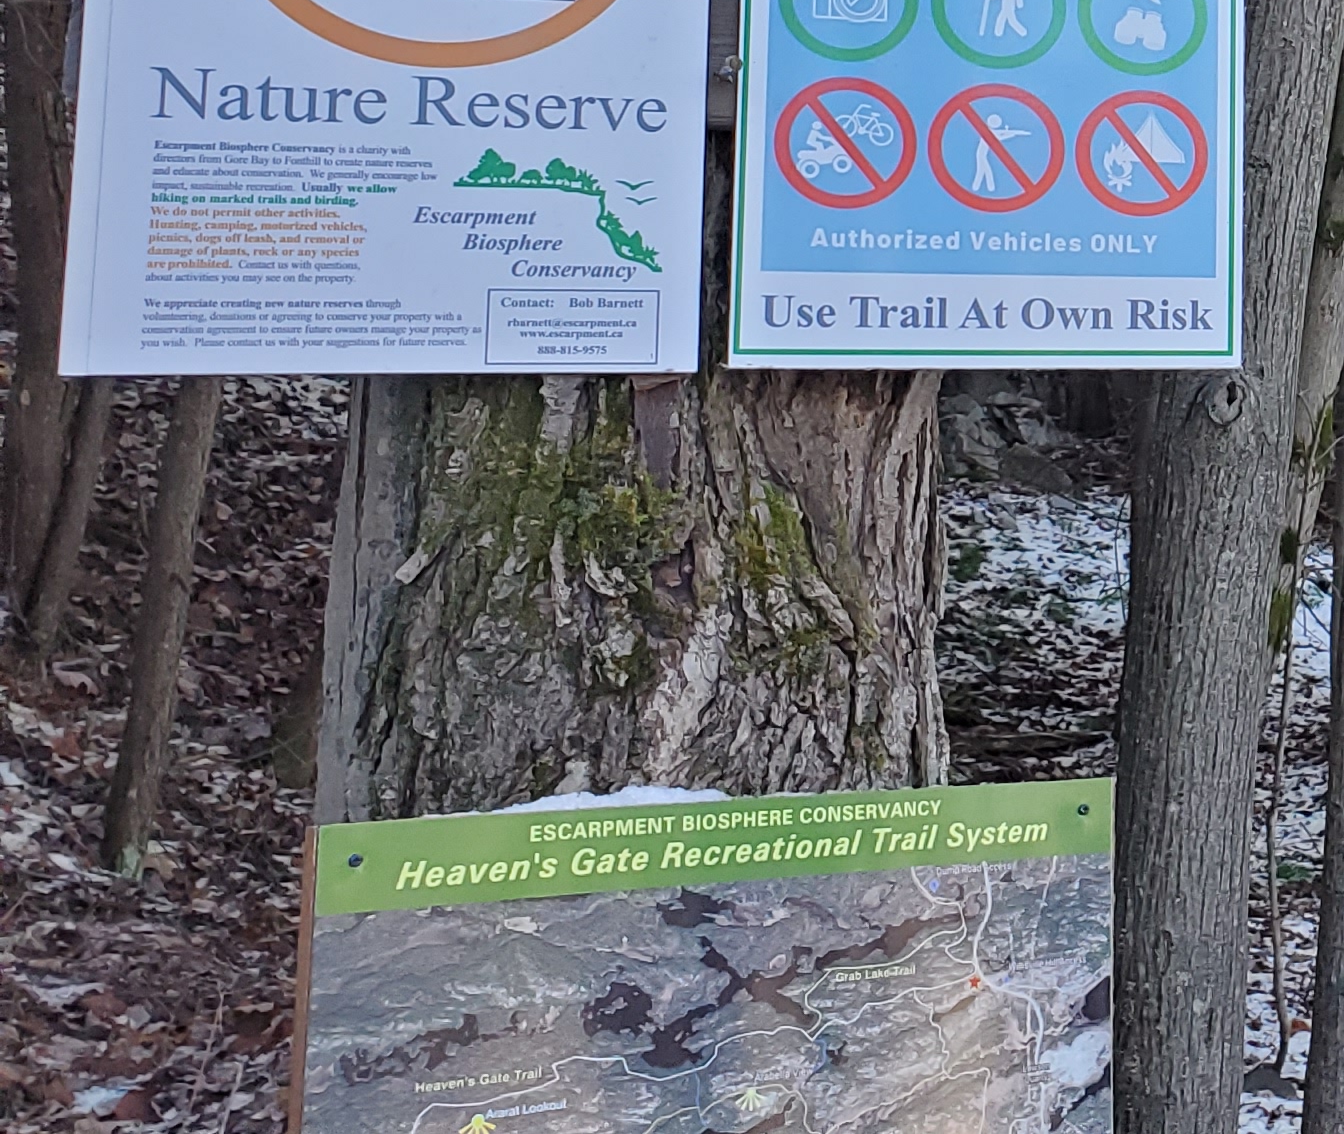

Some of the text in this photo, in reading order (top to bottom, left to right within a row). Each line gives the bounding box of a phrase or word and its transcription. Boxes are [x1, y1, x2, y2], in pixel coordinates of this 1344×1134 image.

[150, 66, 667, 132] Nature Reserve
[219, 142, 269, 153] Biosphere
[272, 142, 335, 155] Conservancy
[339, 144, 346, 154] is
[356, 145, 388, 156] charity
[391, 146, 411, 155] with
[224, 154, 249, 164] Gore
[251, 155, 269, 166] Bay
[272, 156, 282, 164] to
[324, 157, 333, 166] to
[212, 167, 238, 176] about
[310, 169, 325, 178] We
[301, 182, 397, 194] Usually we allow
[151, 193, 188, 205] hiking
[192, 195, 206, 203] on
[210, 194, 254, 204] marked
[258, 195, 287, 204] trails
[290, 195, 311, 204] and
[150, 206, 169, 216] We
[173, 206, 187, 216] do
[191, 208, 209, 216] not
[213, 207, 251, 219] permit
[255, 208, 285, 217] other
[413, 206, 537, 228] Escarpment
[149, 219, 201, 231] Hunting,
[205, 220, 258, 232] camping,
[321, 222, 367, 232] vehicles,
[148, 233, 192, 244] picnics,
[196, 233, 221, 244] dogs
[225, 234, 242, 242] off
[244, 234, 276, 244] leash,
[279, 234, 301, 243] and
[304, 235, 349, 244] removal
[462, 233, 563, 255] Biosphere
[810, 227, 1158, 254] Authorized Vehicles ONLY
[147, 246, 359, 259] damage of plants, rock or any species
[147, 260, 165, 268] are
[511, 260, 637, 282] Conservancy
[221, 274, 239, 284] you
[242, 274, 262, 284] may
[298, 273, 312, 282] the
[144, 298, 161, 307] We
[220, 298, 261, 309] creating
[265, 300, 284, 308] new
[288, 299, 320, 308] nature
[323, 300, 363, 308] reserves
[366, 299, 401, 310] through
[500, 296, 644, 309] Contact: Bob Barnett
[762, 294, 1213, 331] Use Trail At Own Risk
[507, 317, 637, 329] rbarnett@escarpment.ca
[519, 329, 623, 340] www.escarpment.ca
[537, 345, 607, 355] 888-815-9575
[529, 799, 942, 842] ESCARPMENT BIOSPHERE CONSERVANCY
[395, 821, 1049, 891] Heaven's Gate Recreational Trail System
[835, 971, 861, 982] Grab
[415, 1066, 543, 1094] Heaven's Gate Trail
[522, 1098, 567, 1114] Lookout
